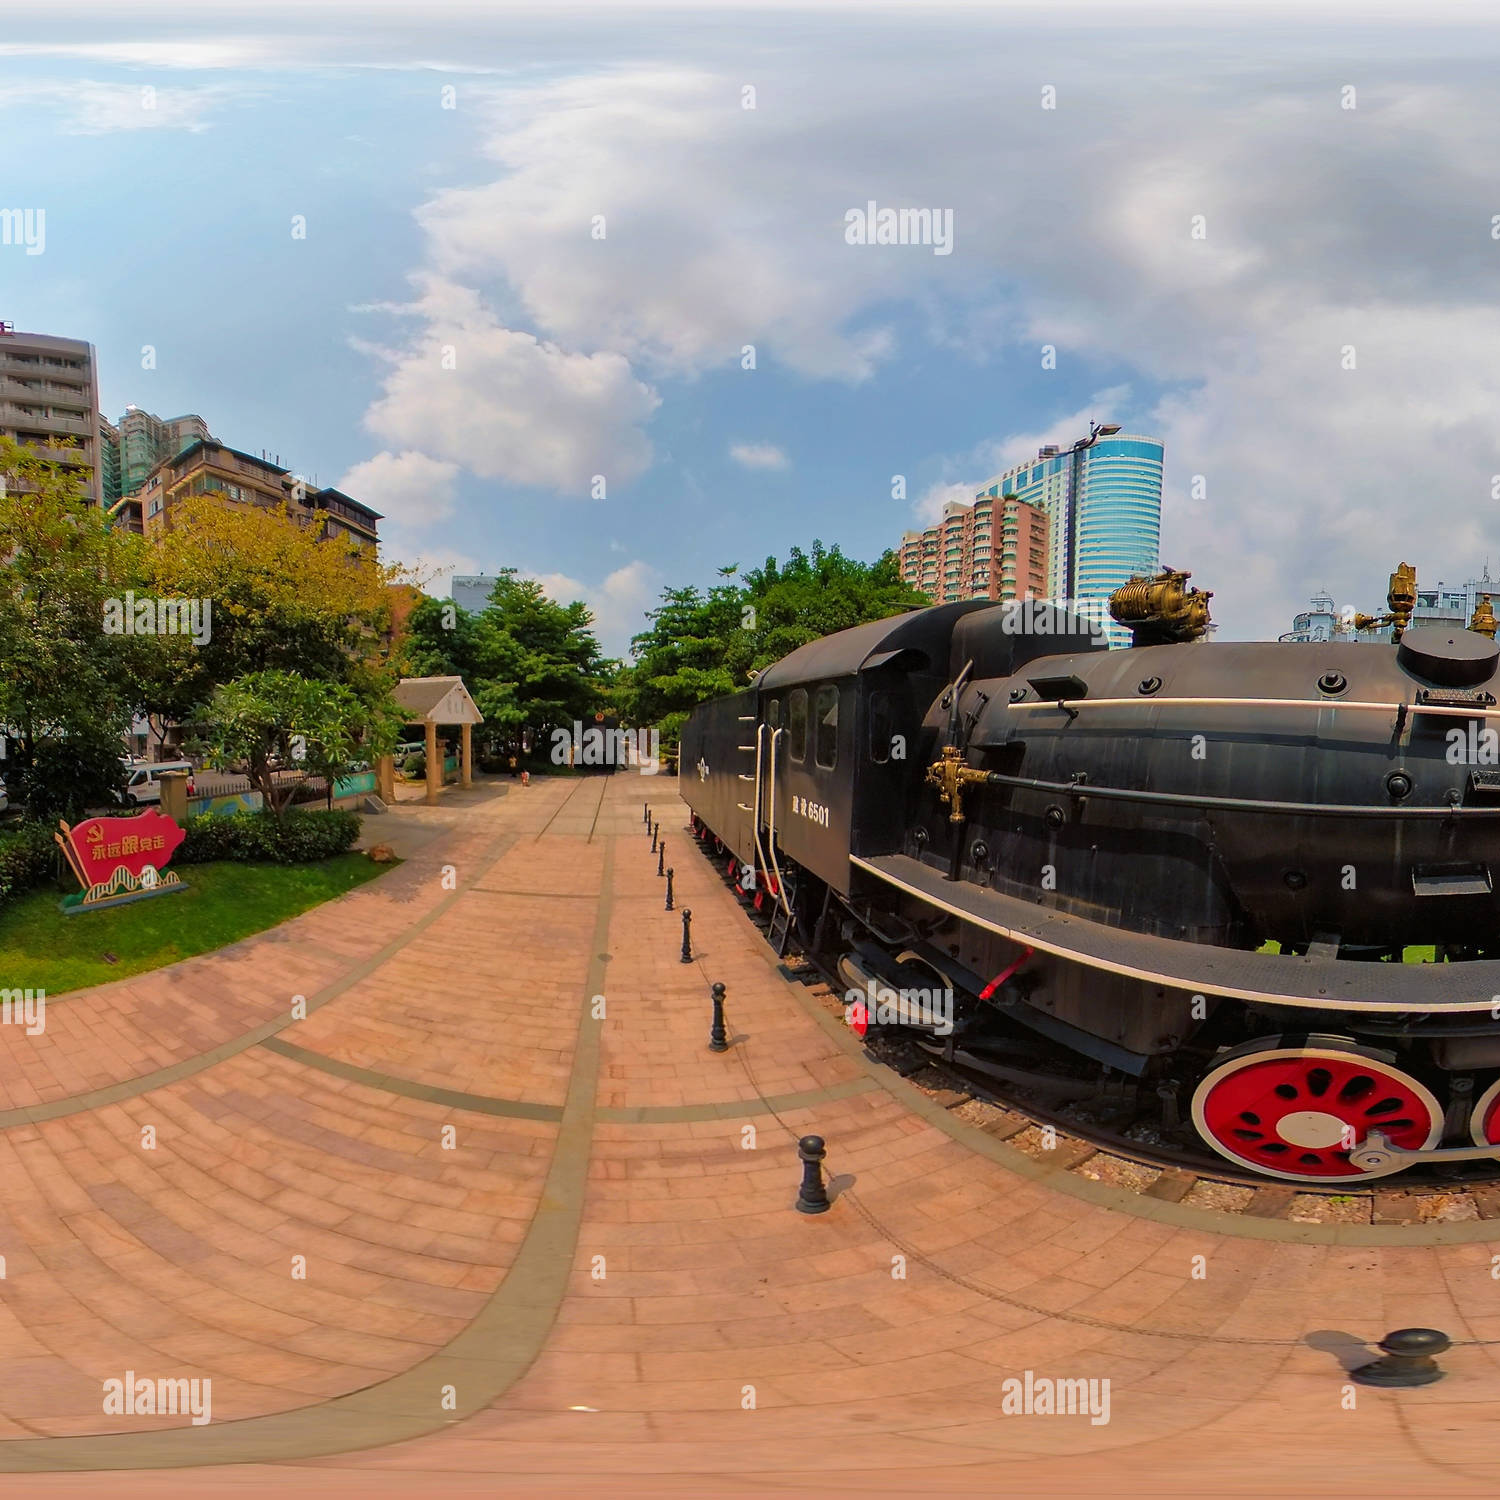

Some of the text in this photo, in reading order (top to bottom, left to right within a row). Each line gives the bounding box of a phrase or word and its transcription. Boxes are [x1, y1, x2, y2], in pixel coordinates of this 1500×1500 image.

[808, 801, 829, 828] 6501
[92, 835, 165, 860] 永远跟党走
